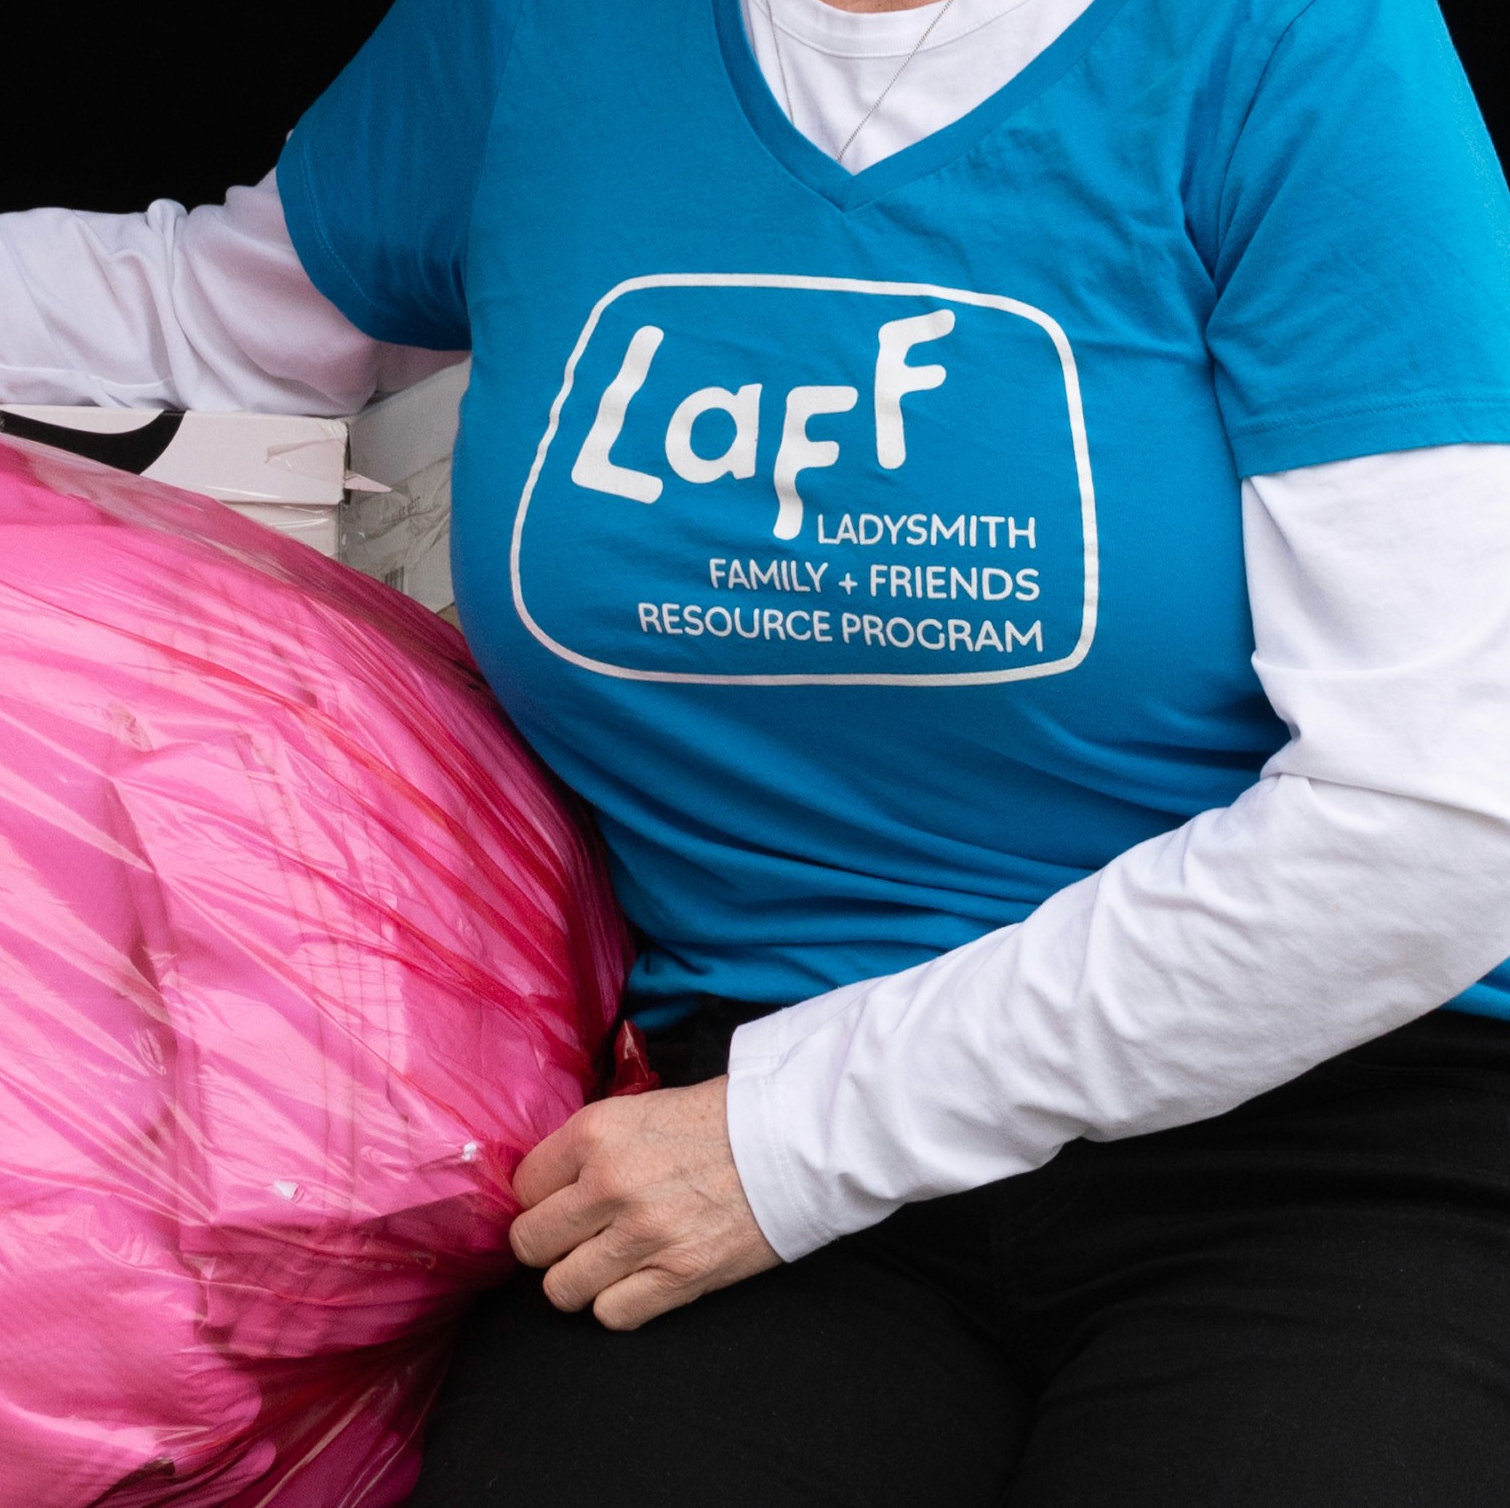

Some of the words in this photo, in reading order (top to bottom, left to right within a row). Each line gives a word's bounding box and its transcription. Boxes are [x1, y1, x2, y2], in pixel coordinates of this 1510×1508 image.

[817, 513, 1036, 549] LADYSMITH
[709, 558, 828, 592] FAMILY
[838, 573, 858, 594] +
[870, 564, 1040, 601] FRIENDS
[638, 602, 833, 642] RESOURCE
[841, 612, 1043, 653] PROGRAM
